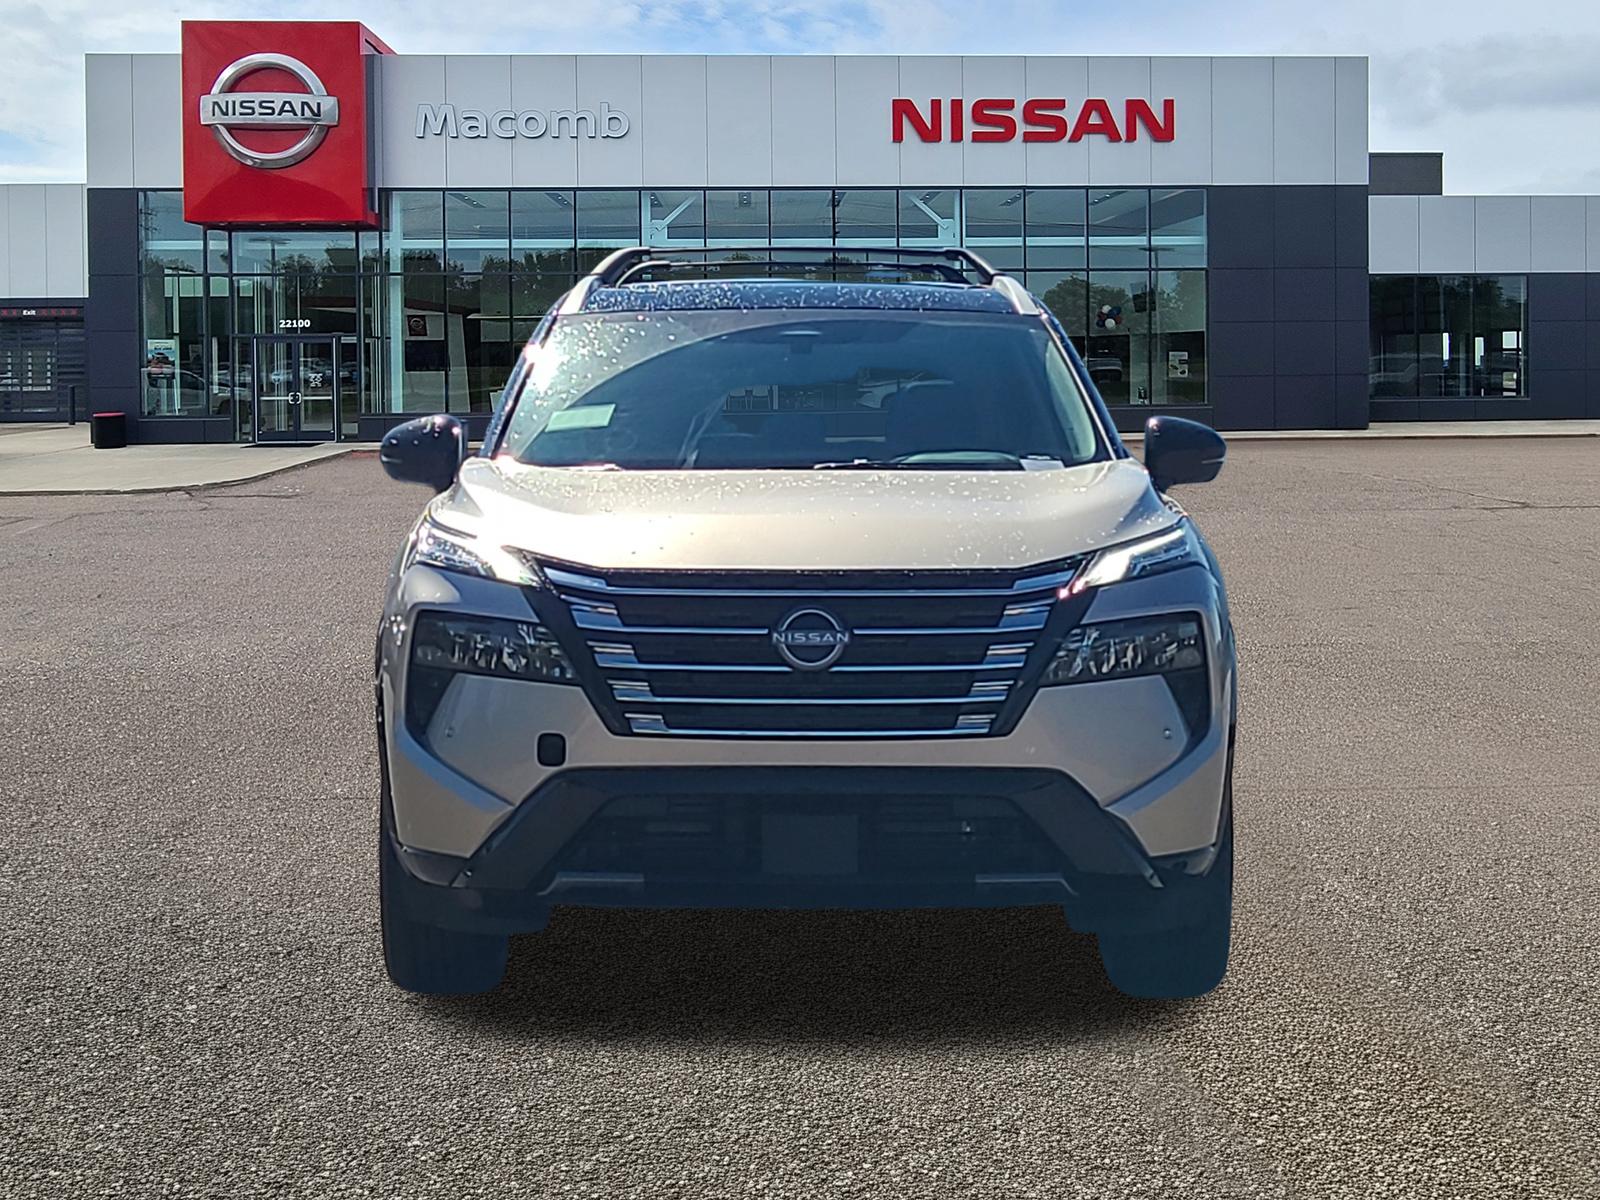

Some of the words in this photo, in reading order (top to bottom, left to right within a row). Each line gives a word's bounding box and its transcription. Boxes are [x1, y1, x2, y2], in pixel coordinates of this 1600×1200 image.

[212, 100, 322, 117] NISSAN
[415, 101, 630, 139] Macomb
[892, 98, 1175, 143] NISSAN
[279, 319, 311, 328] 22100
[772, 632, 849, 643] NISSAN
